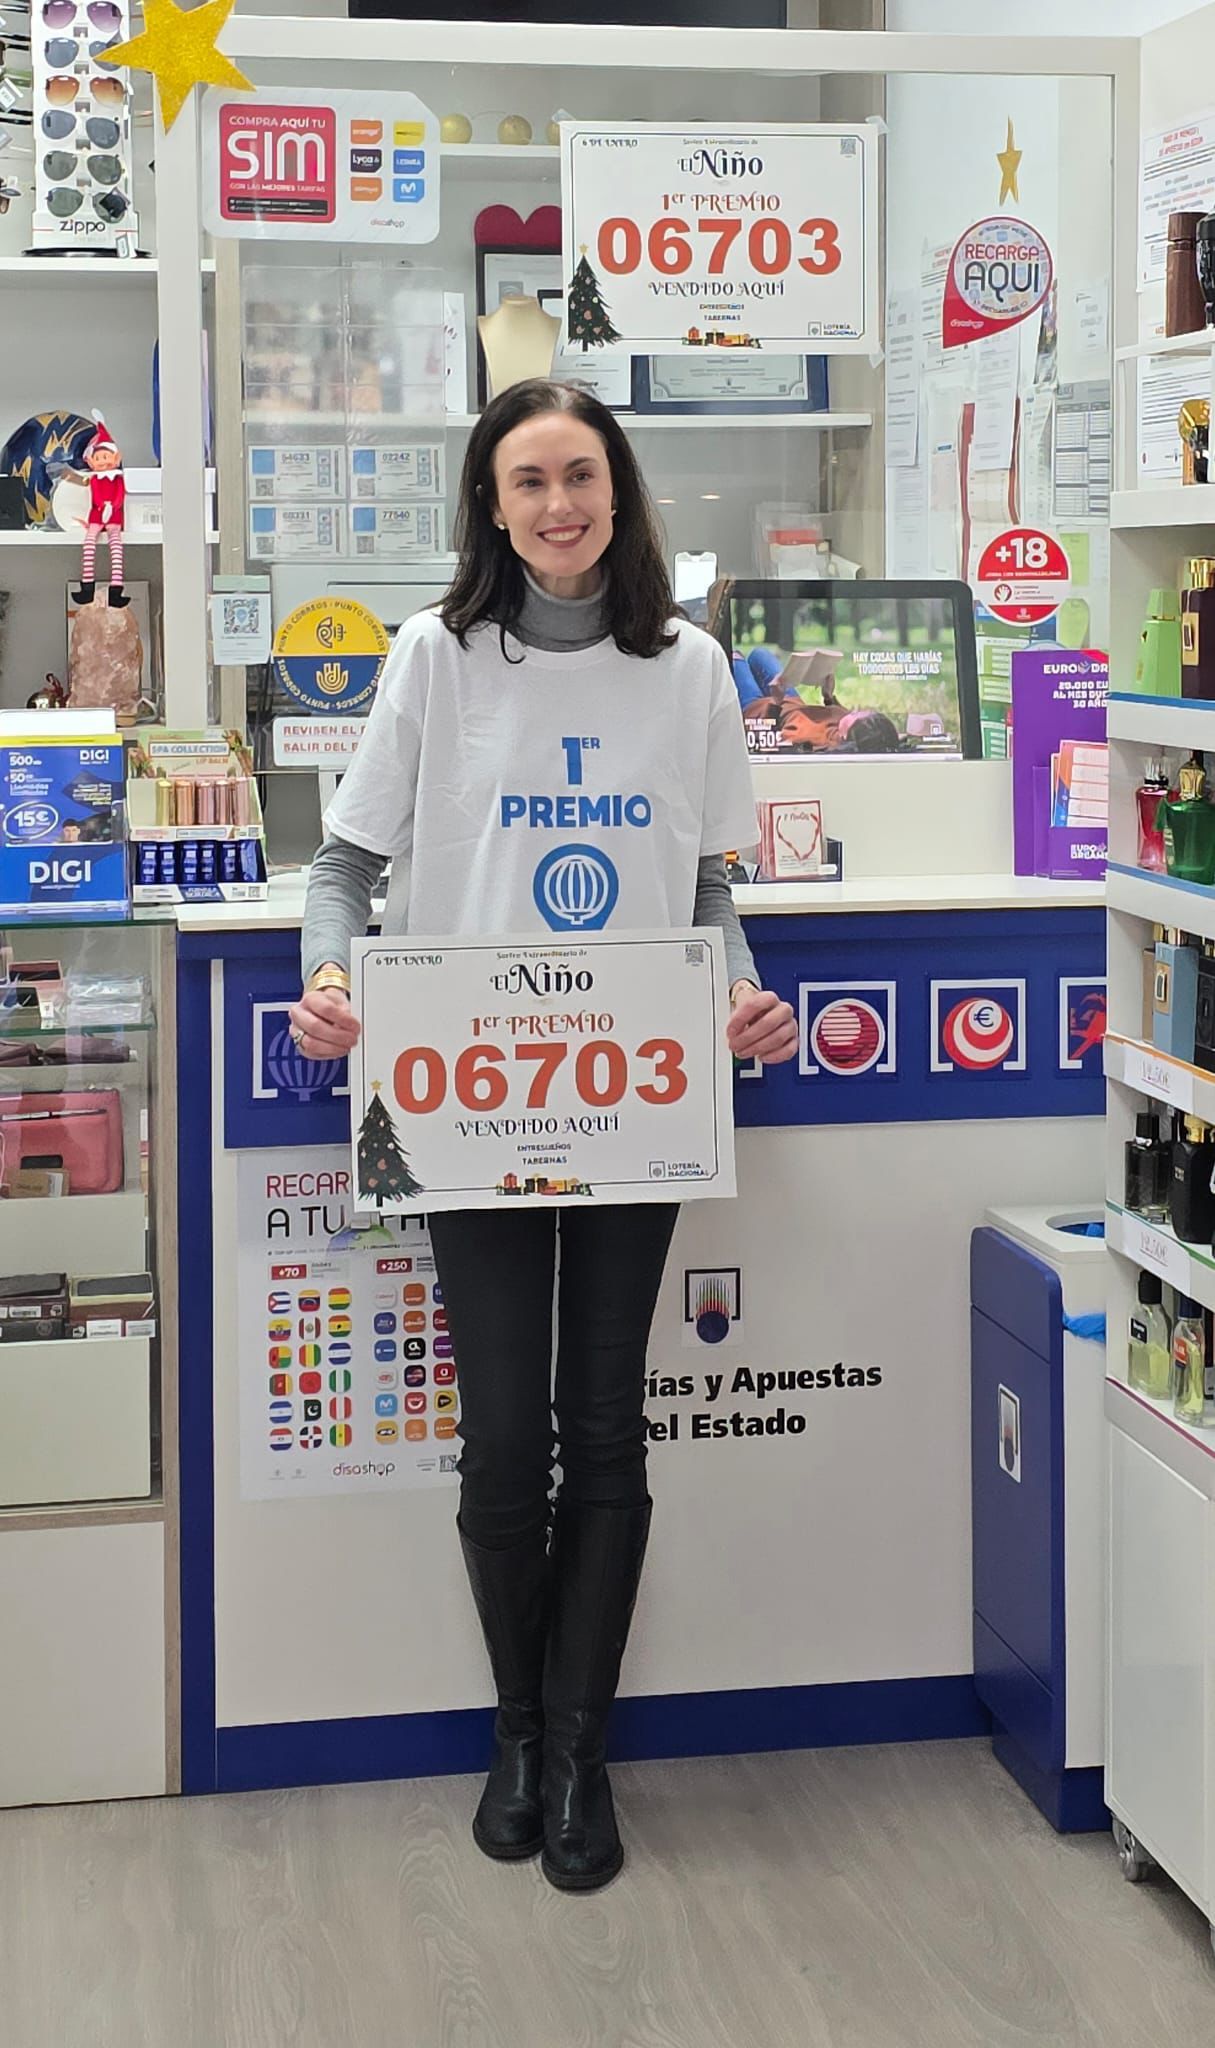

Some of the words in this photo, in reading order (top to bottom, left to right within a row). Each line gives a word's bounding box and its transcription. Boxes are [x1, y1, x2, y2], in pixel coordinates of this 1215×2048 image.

[229, 115, 278, 127] COMPRA
[280, 117, 309, 129] AQUÍ
[312, 119, 326, 128] TU
[589, 139, 602, 148] DE
[605, 139, 638, 148] ENERO
[227, 130, 326, 182] SIM
[352, 154, 374, 164] Lyca
[677, 158, 693, 172] El
[692, 149, 763, 178] Niño
[662, 194, 685, 210] 1er
[690, 191, 780, 214] PREMIO
[60, 219, 106, 235] zippo
[597, 217, 842, 276] 06703
[965, 244, 1040, 261] RECARGA
[648, 282, 734, 298] VENDIDO
[736, 280, 784, 299] AQUÍ
[964, 261, 1040, 303] AQUI
[995, 537, 1048, 568] +18
[278, 623, 292, 652] PUNTO
[291, 602, 328, 624] CORREOS
[334, 602, 363, 617] PUNTO
[363, 615, 386, 652] CORREOS
[853, 652, 868, 662] HAY
[870, 652, 896, 662] COSAS
[896, 651, 912, 662] QUE
[1043, 664, 1078, 674] EURO
[277, 659, 301, 697] CORREOS
[300, 694, 330, 710] PUNTO
[1053, 690, 1066, 698] AL
[283, 726, 338, 736] REVISEN
[342, 726, 357, 735] EL
[80, 750, 110, 760] DIGI
[171, 744, 227, 754] COLLECTION
[284, 743, 320, 752] SALIR
[324, 742, 348, 752] DEL
[562, 736, 600, 786] 1ER
[14, 810, 49, 827] 15€
[500, 794, 652, 828] PREMIO
[29, 860, 91, 884] DIGI
[376, 958, 382, 966] 6
[384, 957, 400, 966] DE
[402, 955, 442, 966] ENERO
[496, 952, 521, 960] Sorteo
[523, 950, 578, 959] Extraordinario
[490, 974, 508, 990] El
[508, 962, 594, 996] Niño
[470, 1015, 500, 1036] 1er
[506, 1010, 614, 1038] PREMIO
[392, 1039, 688, 1114] 06703
[455, 1117, 558, 1138] VENDIDO
[562, 1112, 620, 1137] AQUÍ
[516, 1142, 572, 1152] ENTRESUEÑOS
[522, 1156, 567, 1164] TABERNAS
[668, 1162, 701, 1170] LOTERÍA
[266, 1172, 350, 1198] RECAR
[268, 1208, 290, 1238] A
[300, 1204, 346, 1236] TU
[278, 1268, 300, 1278] +70
[381, 1262, 408, 1272] +250
[644, 1370, 694, 1398] ías
[704, 1374, 724, 1402] y
[731, 1362, 882, 1399] Apuestas
[644, 1414, 678, 1442] el
[692, 1408, 806, 1439] Estado
[332, 1460, 396, 1477] disashop
